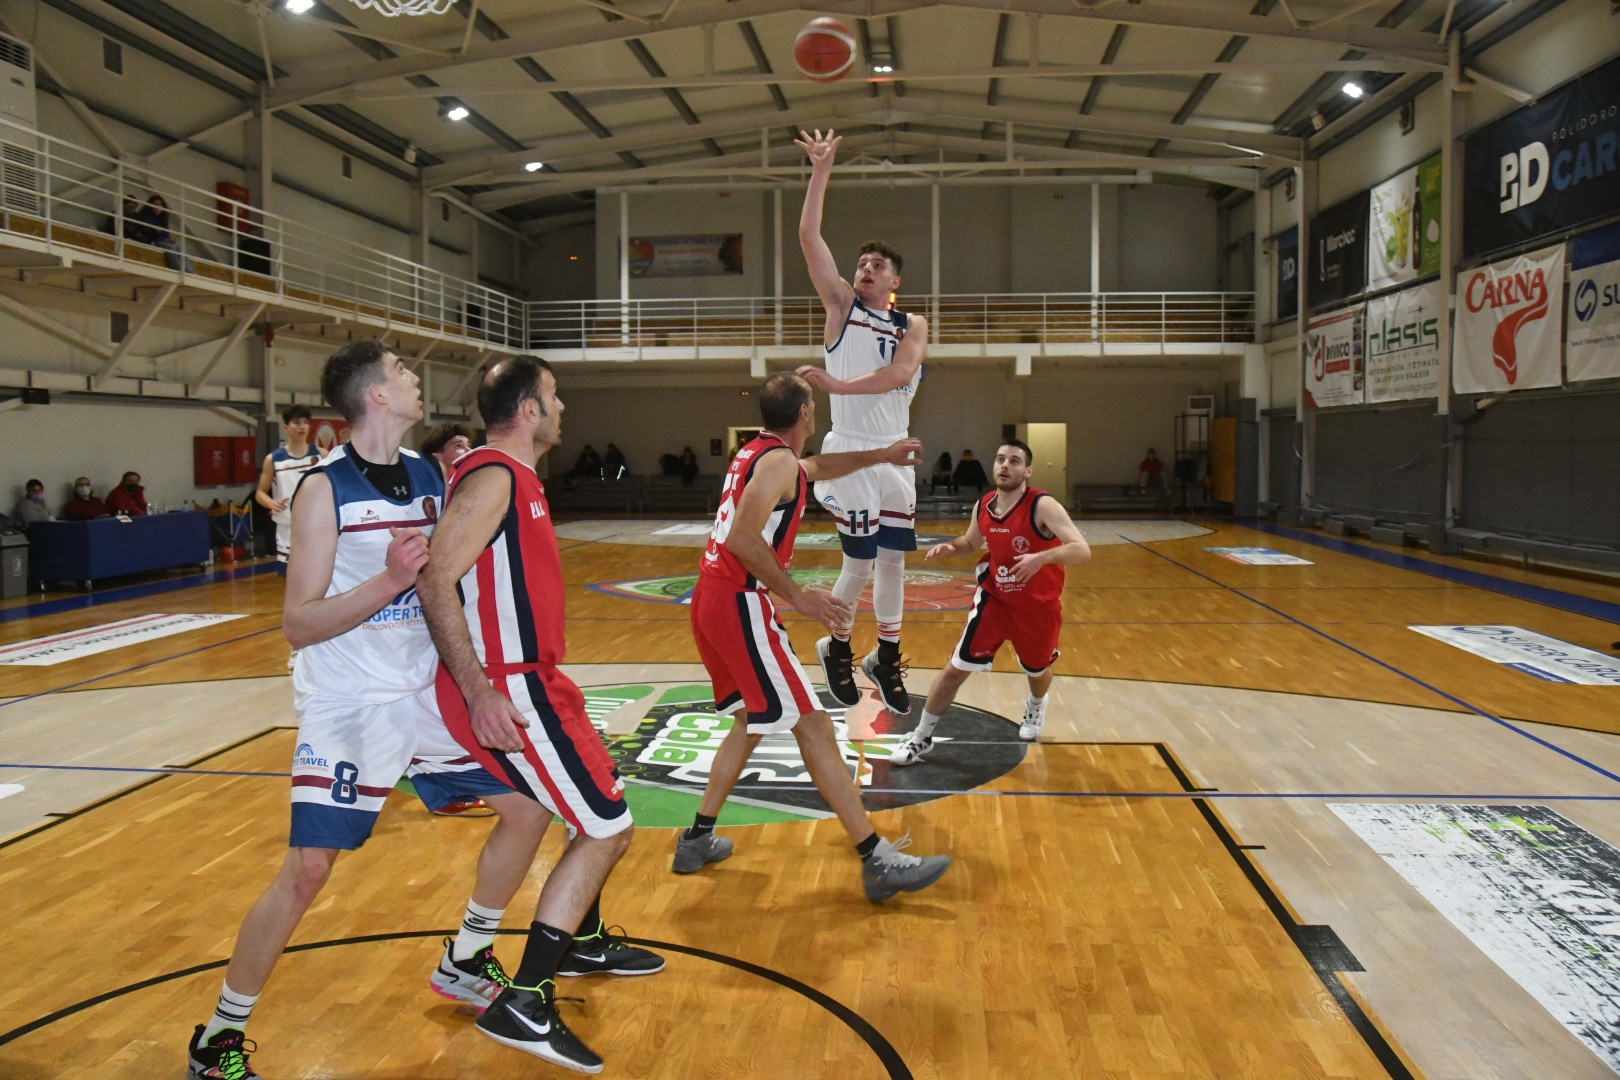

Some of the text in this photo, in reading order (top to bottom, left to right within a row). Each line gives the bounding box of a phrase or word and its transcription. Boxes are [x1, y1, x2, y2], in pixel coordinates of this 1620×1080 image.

[1551, 105, 1617, 142] POLIDORO
[1552, 131, 1620, 191] CAR
[1466, 267, 1547, 313] CARNA
[847, 509, 870, 534] 11
[364, 608, 410, 622] UPER
[331, 760, 359, 805] 8
